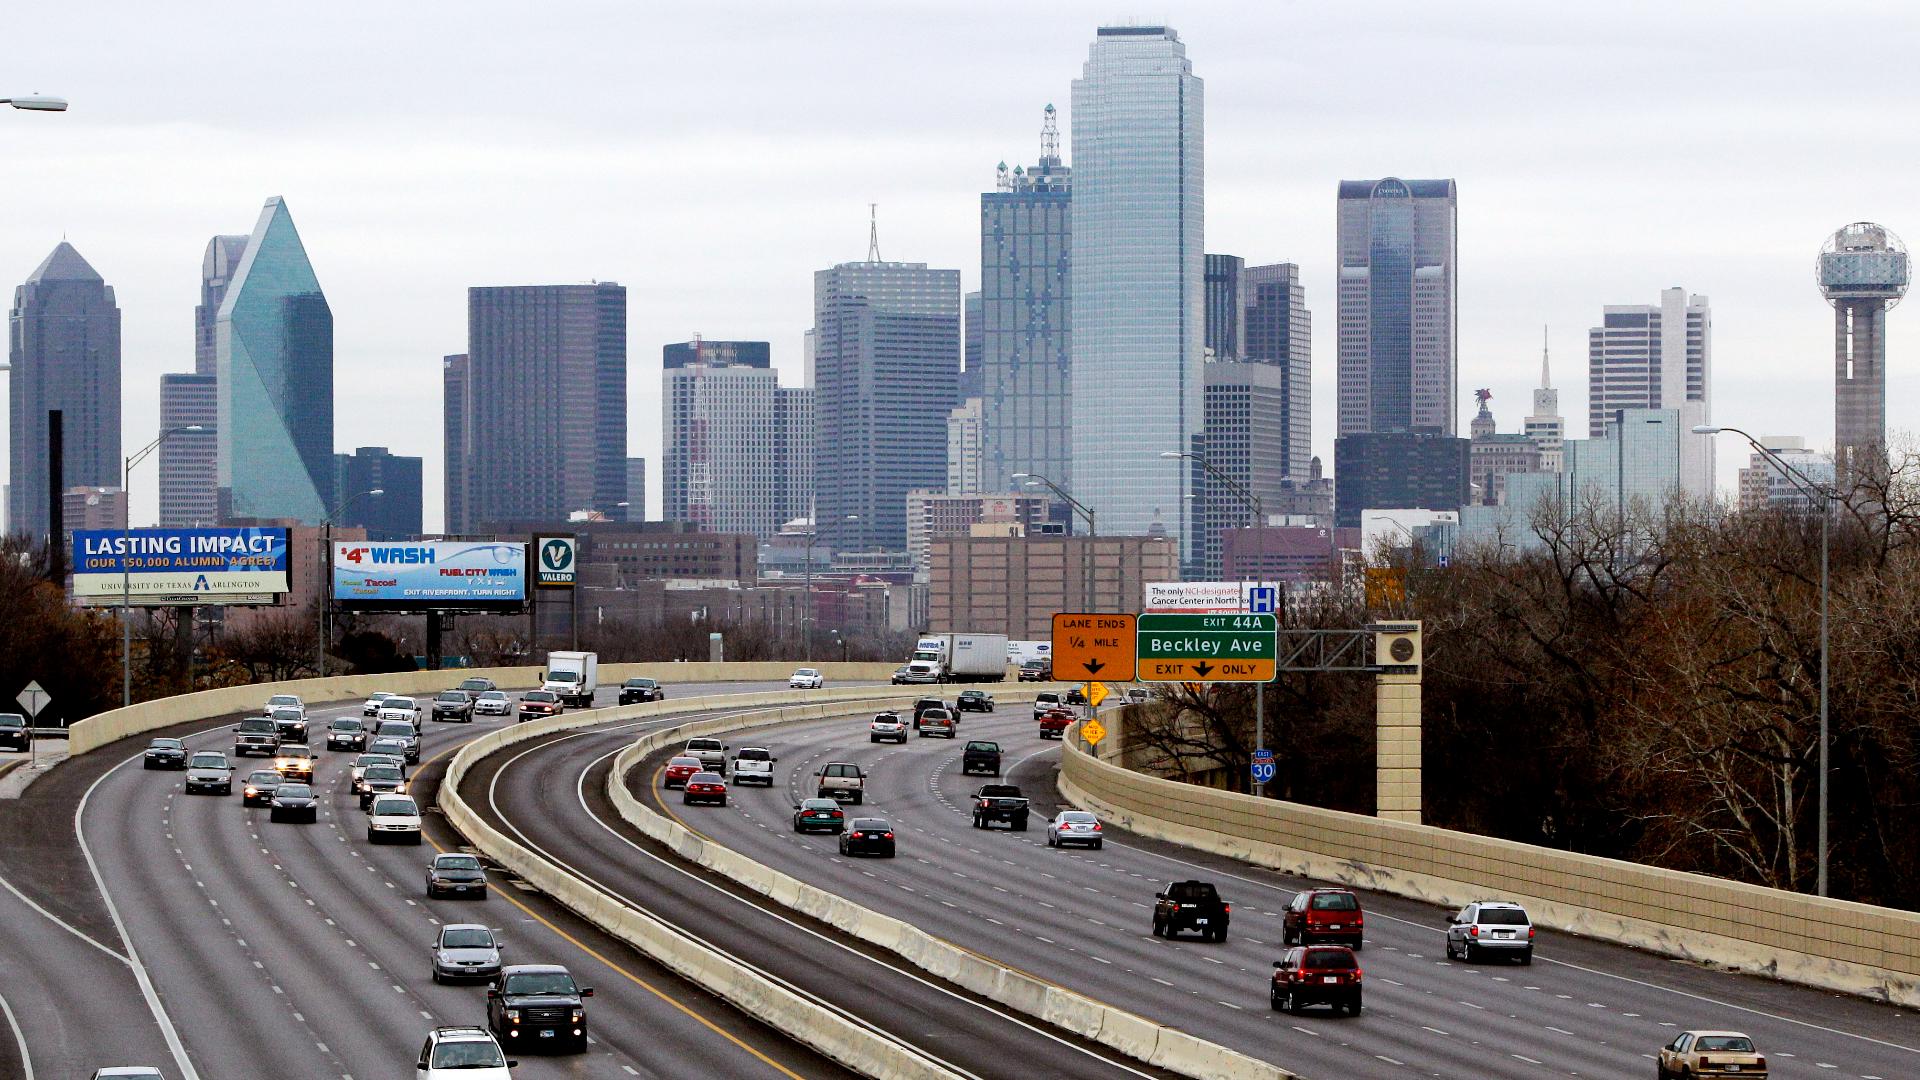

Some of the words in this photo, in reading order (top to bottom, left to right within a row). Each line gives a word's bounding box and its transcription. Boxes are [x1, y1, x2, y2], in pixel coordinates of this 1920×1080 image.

[85, 537, 181, 555] LASTING
[190, 536, 275, 553] IMPACT
[370, 547, 436, 564] WASH
[85, 558, 116, 569] (OUR
[174, 557, 225, 567] ALUMNI
[230, 556, 276, 567] AGREE)
[439, 568, 464, 577] FUEL
[465, 568, 488, 577] CITY
[488, 568, 517, 577] WASH
[541, 573, 573, 582] VALERO
[167, 581, 192, 589] TEXAS
[364, 578, 397, 587] Tacos!
[1167, 587, 1184, 598] only
[1180, 597, 1204, 605] Center
[1063, 620, 1092, 628] LANE
[1098, 620, 1126, 629] ENDS
[1203, 618, 1226, 627] EXIT
[1232, 616, 1263, 629] 44A
[1094, 638, 1119, 647] MILE
[1151, 638, 1221, 655] Beckley
[1230, 638, 1263, 652] Ave
[1156, 664, 1184, 674] EXIT
[1222, 664, 1257, 674] ONLY
[1254, 764, 1274, 778] 30
